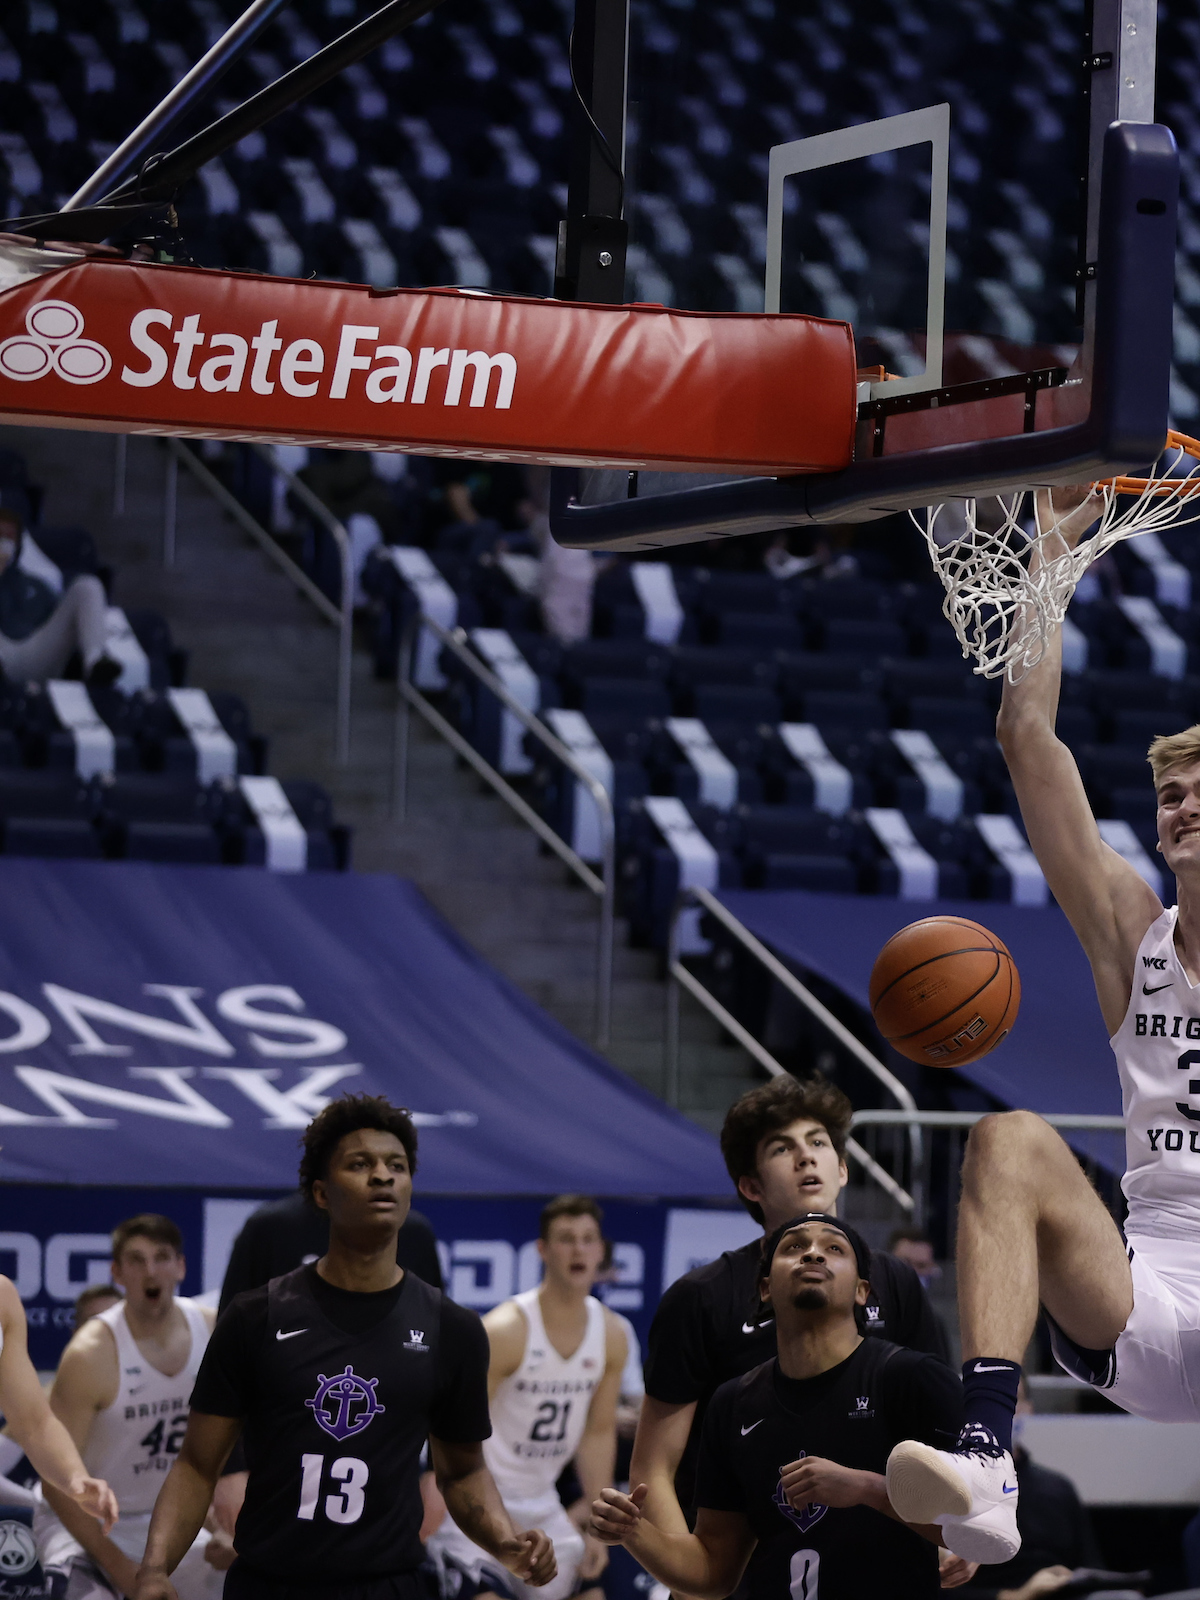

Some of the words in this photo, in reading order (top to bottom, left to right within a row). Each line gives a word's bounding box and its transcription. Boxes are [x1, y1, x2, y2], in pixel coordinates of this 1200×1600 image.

[1142, 957, 1168, 970] WCC
[141, 1414, 189, 1456] 42
[530, 1400, 572, 1442] 21
[297, 1453, 370, 1525] 13
[790, 1548, 820, 1600] 0
